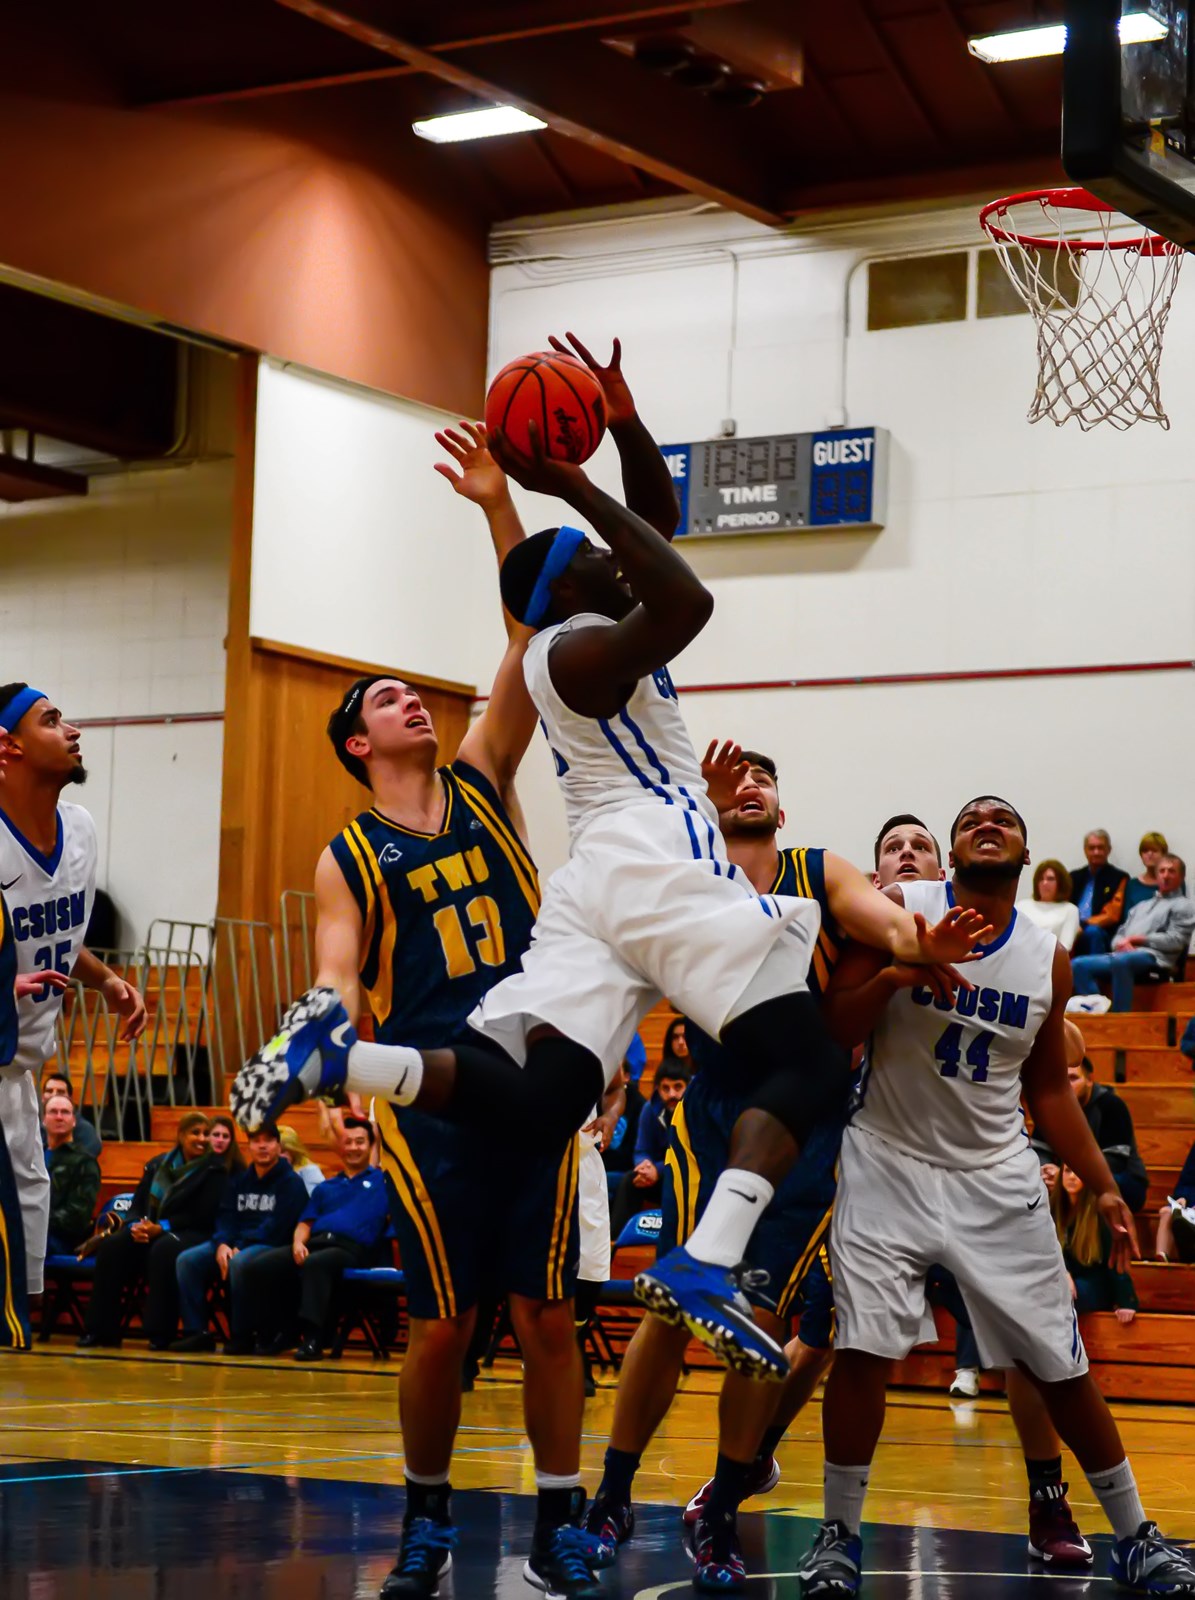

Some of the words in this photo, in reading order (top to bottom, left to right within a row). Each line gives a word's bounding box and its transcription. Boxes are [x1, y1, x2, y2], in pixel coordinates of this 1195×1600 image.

[813, 437, 875, 467] GUEST
[717, 511, 780, 528] PERIOD
[719, 484, 778, 505] TIME
[406, 845, 490, 904] TMU
[12, 890, 86, 942] CSUSM
[432, 895, 506, 980] 13
[31, 939, 72, 1003] 35
[934, 1021, 996, 1083] 44
